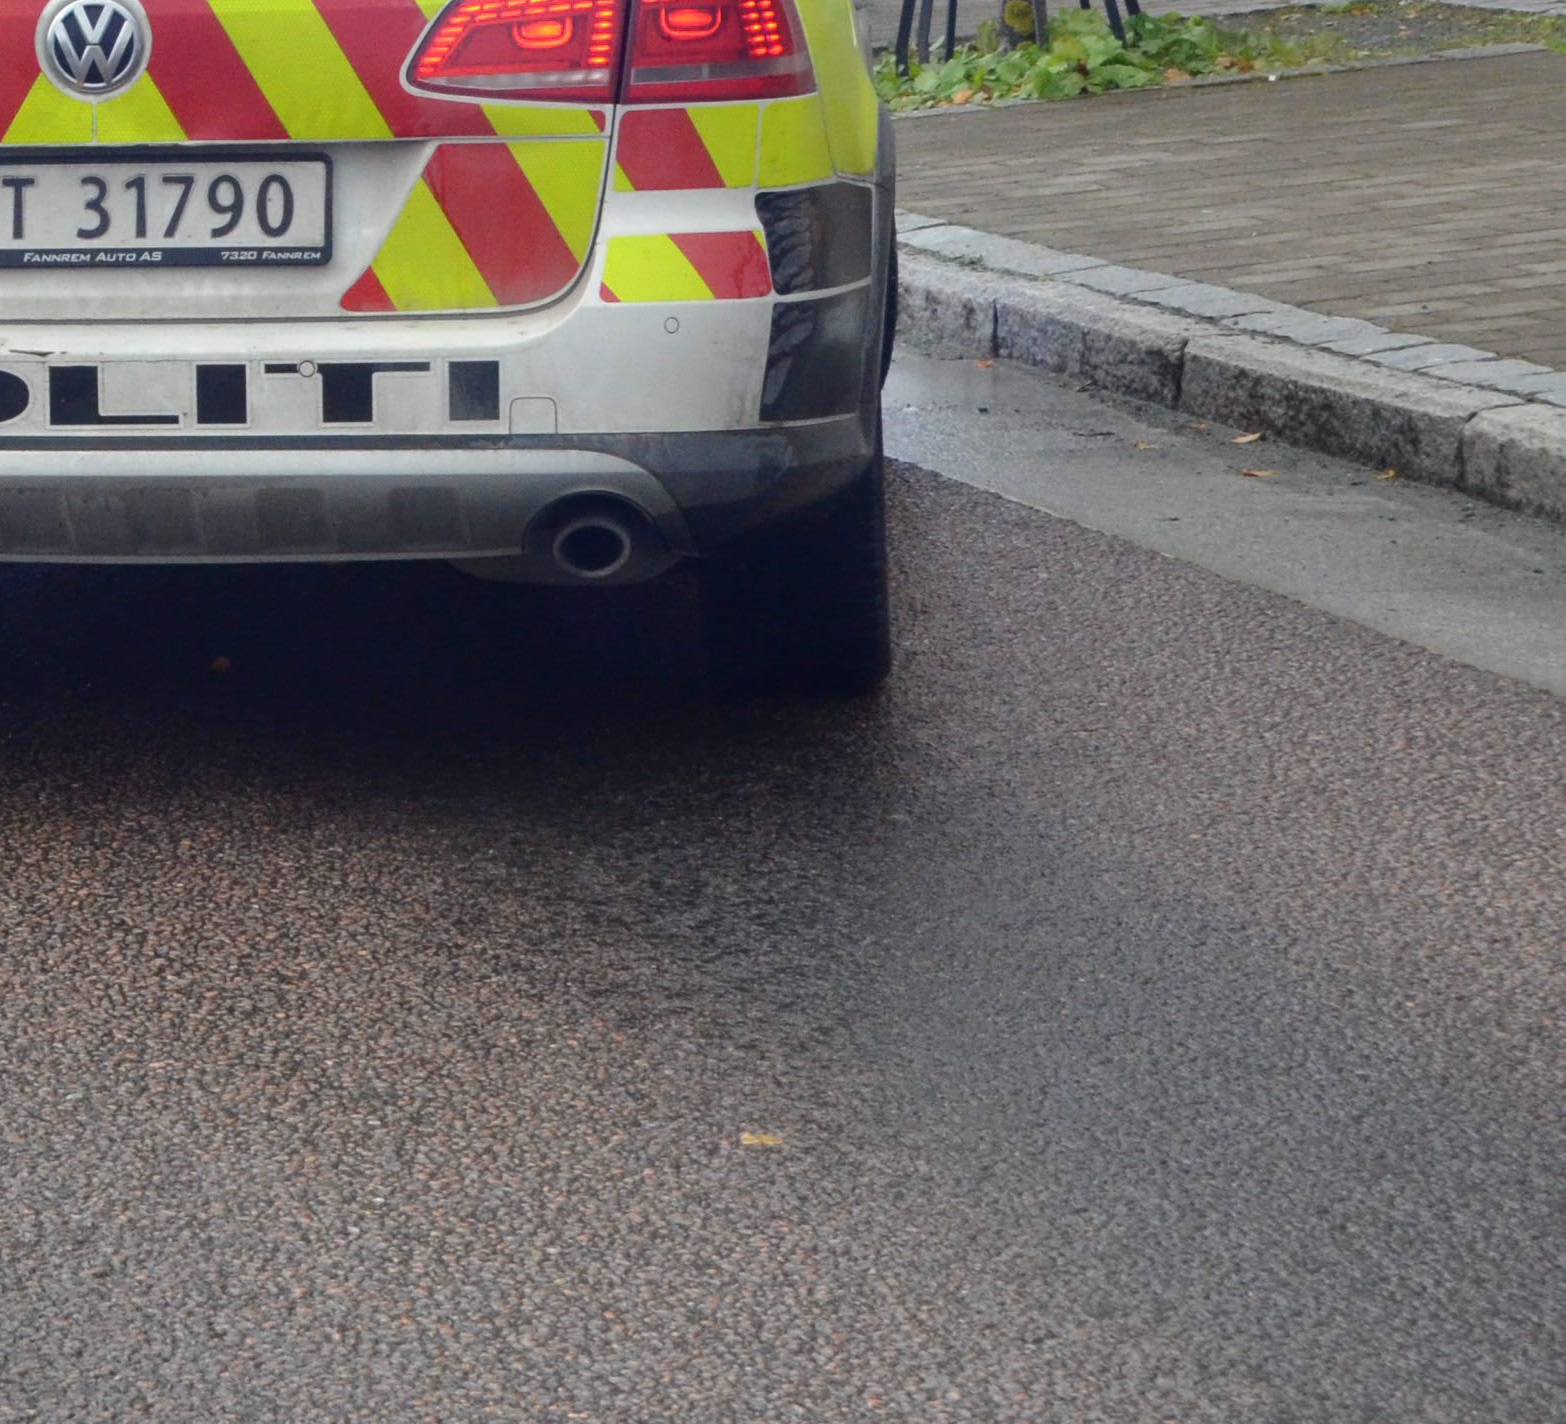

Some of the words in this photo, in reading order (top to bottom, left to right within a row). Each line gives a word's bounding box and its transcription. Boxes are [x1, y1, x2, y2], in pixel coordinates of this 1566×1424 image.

[75, 173, 295, 241] 31790
[139, 250, 163, 263] AS
[220, 250, 257, 262] 7320
